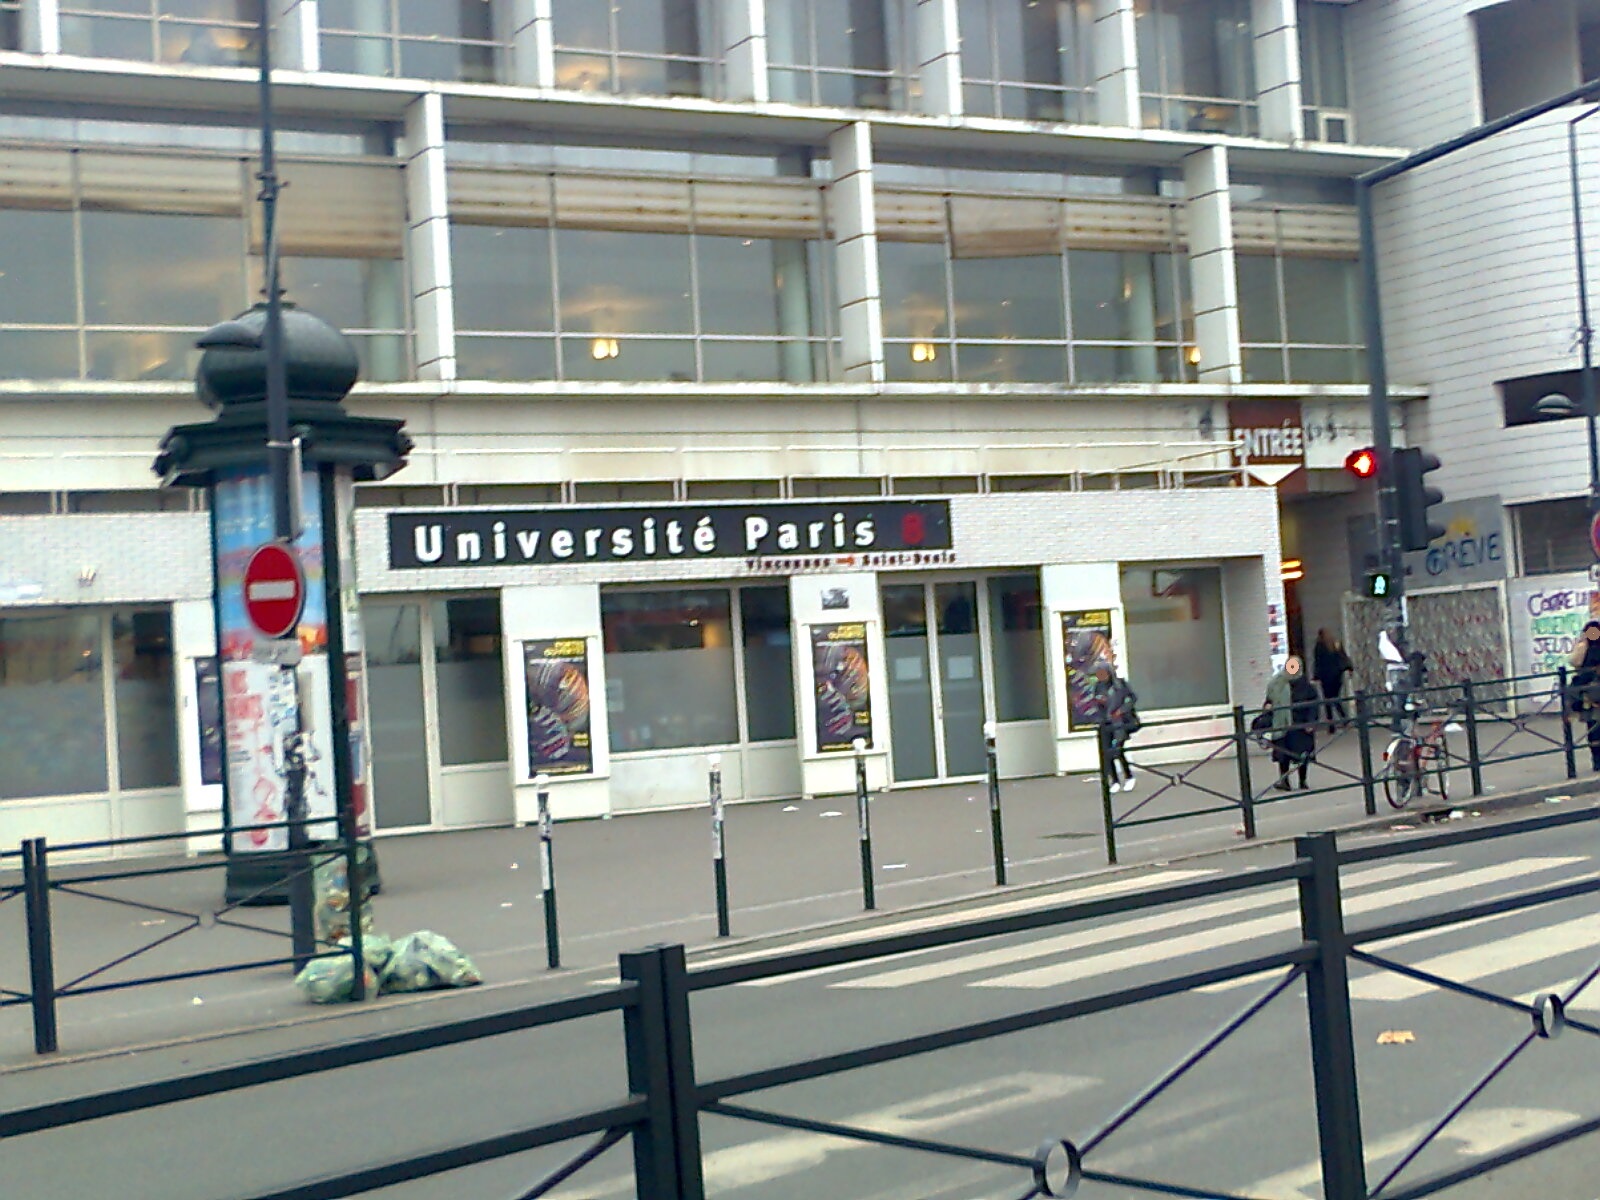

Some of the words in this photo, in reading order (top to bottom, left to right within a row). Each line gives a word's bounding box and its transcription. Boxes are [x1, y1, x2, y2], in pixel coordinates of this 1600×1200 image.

[1233, 418, 1303, 457] ENTRÉE
[414, 516, 716, 563] Université
[745, 512, 876, 551] Paris
